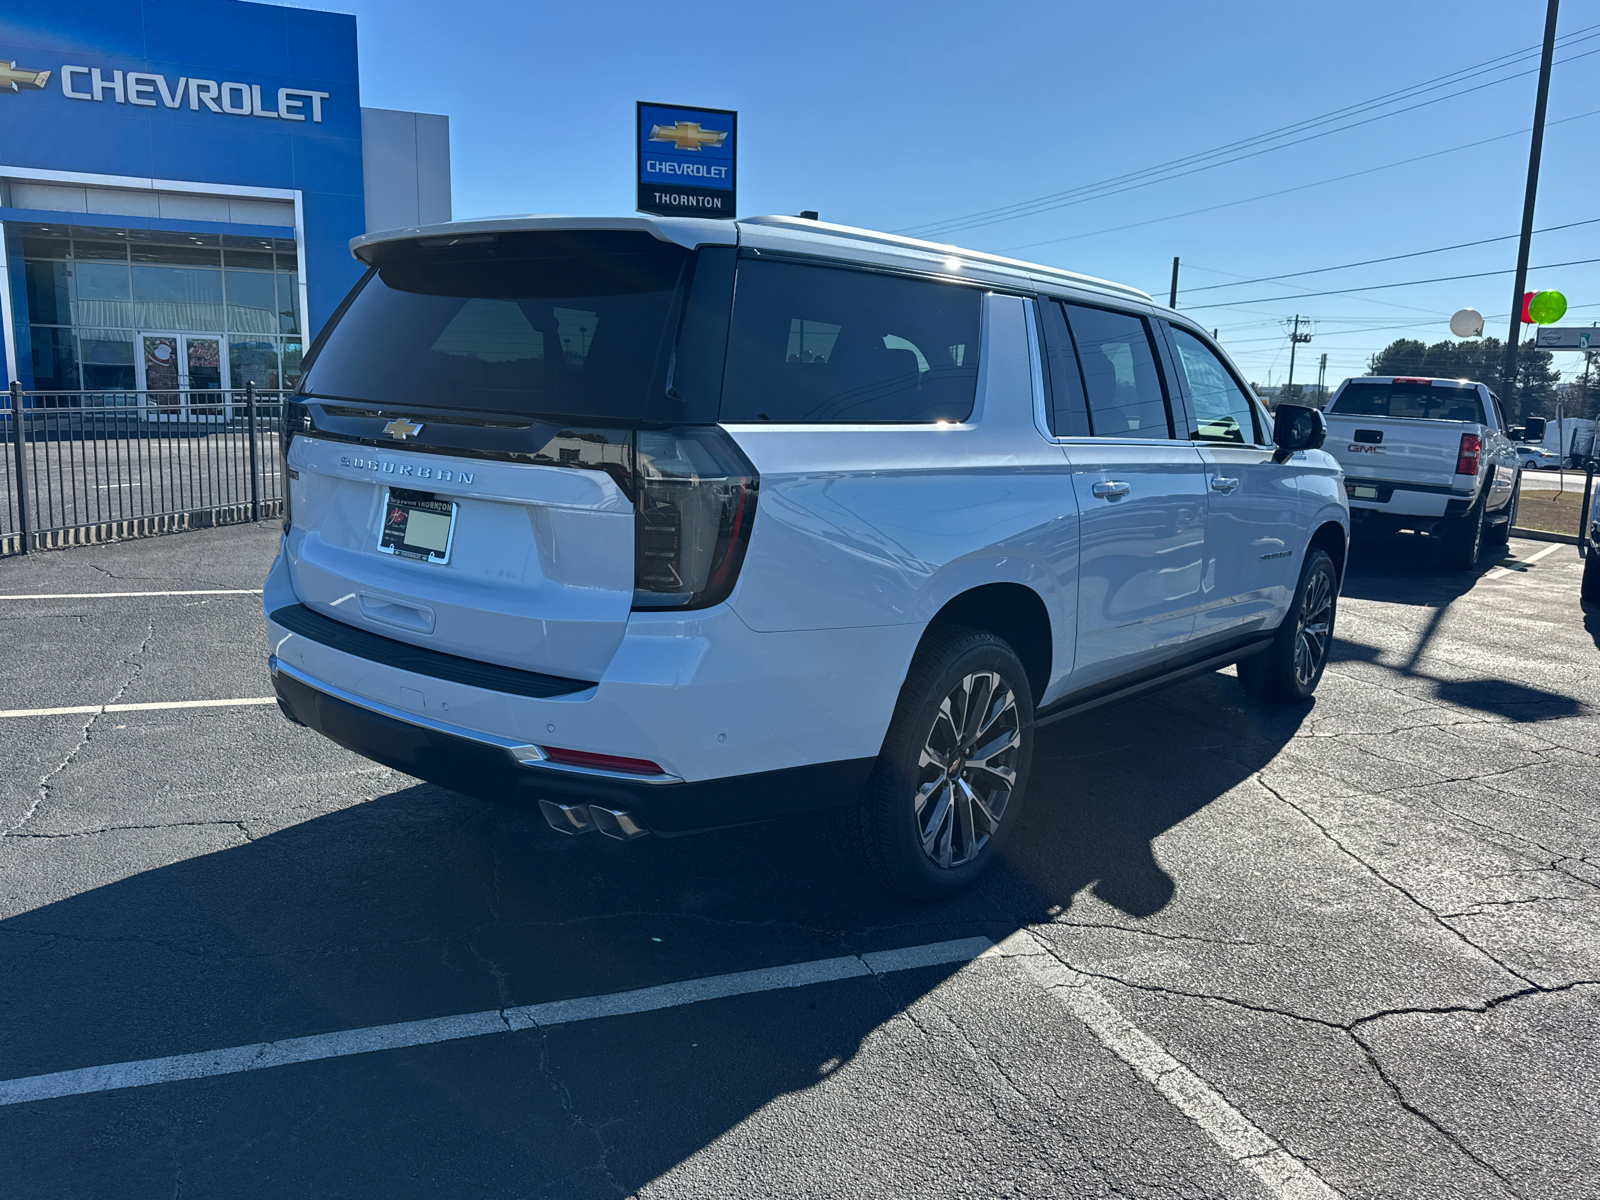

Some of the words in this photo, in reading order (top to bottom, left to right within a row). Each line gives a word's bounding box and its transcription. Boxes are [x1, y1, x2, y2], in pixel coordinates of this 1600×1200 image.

[61, 64, 330, 123] CHEVROLET
[646, 160, 728, 179] CHEVROLET
[654, 192, 721, 208] THORNTON
[1347, 444, 1386, 454] GMC
[340, 456, 475, 485] SUBURBAN
